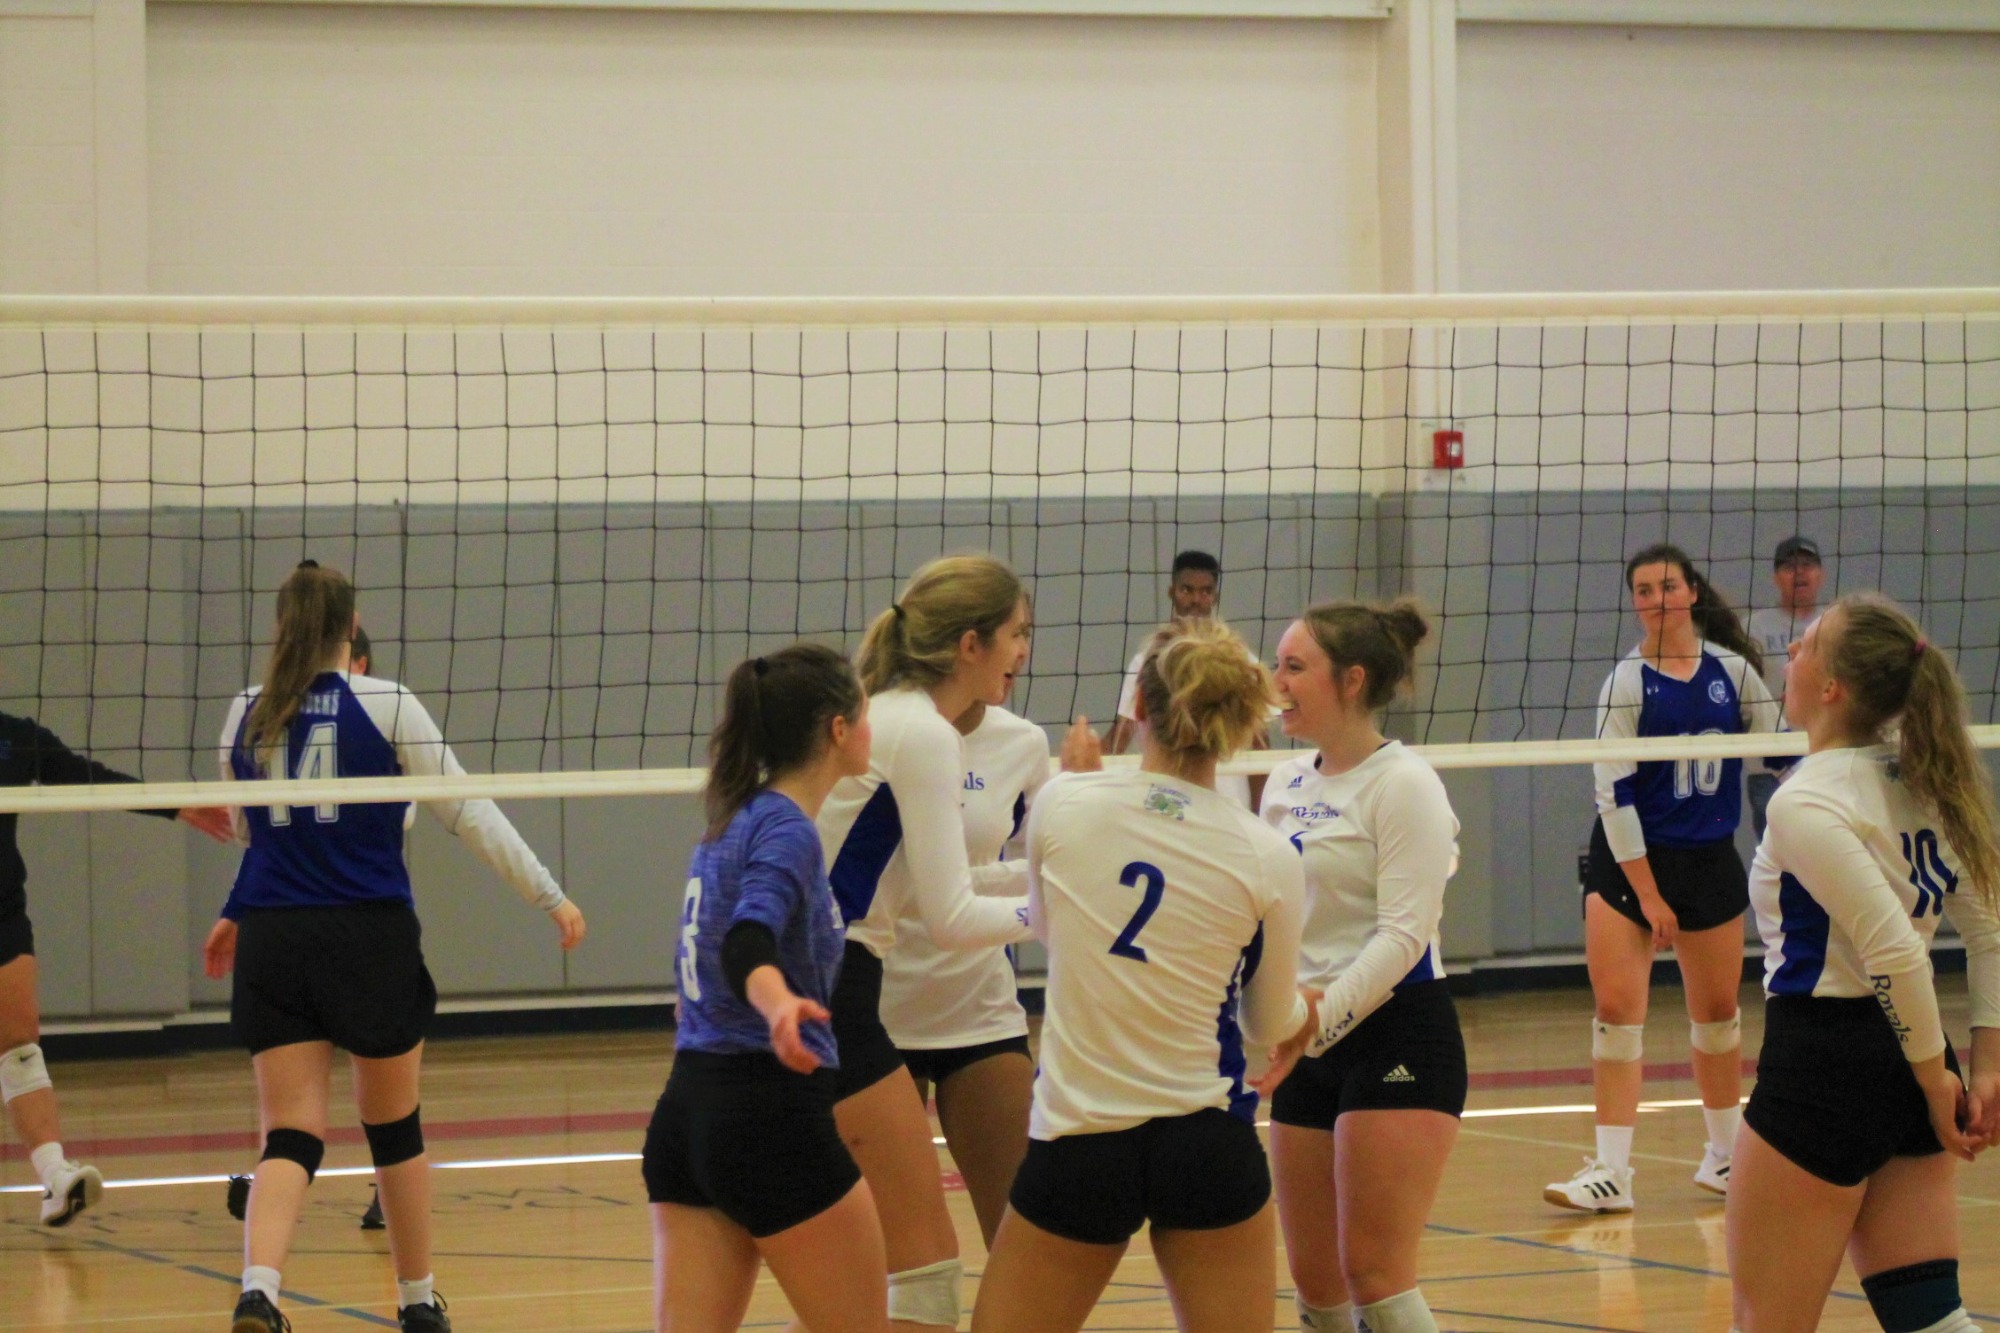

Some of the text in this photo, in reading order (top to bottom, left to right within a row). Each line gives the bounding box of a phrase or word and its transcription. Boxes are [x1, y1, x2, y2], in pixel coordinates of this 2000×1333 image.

[254, 722, 340, 827] 14
[1108, 860, 1165, 962] 2
[1900, 828, 1958, 918] 10
[1382, 1074, 1416, 1083] adidas
